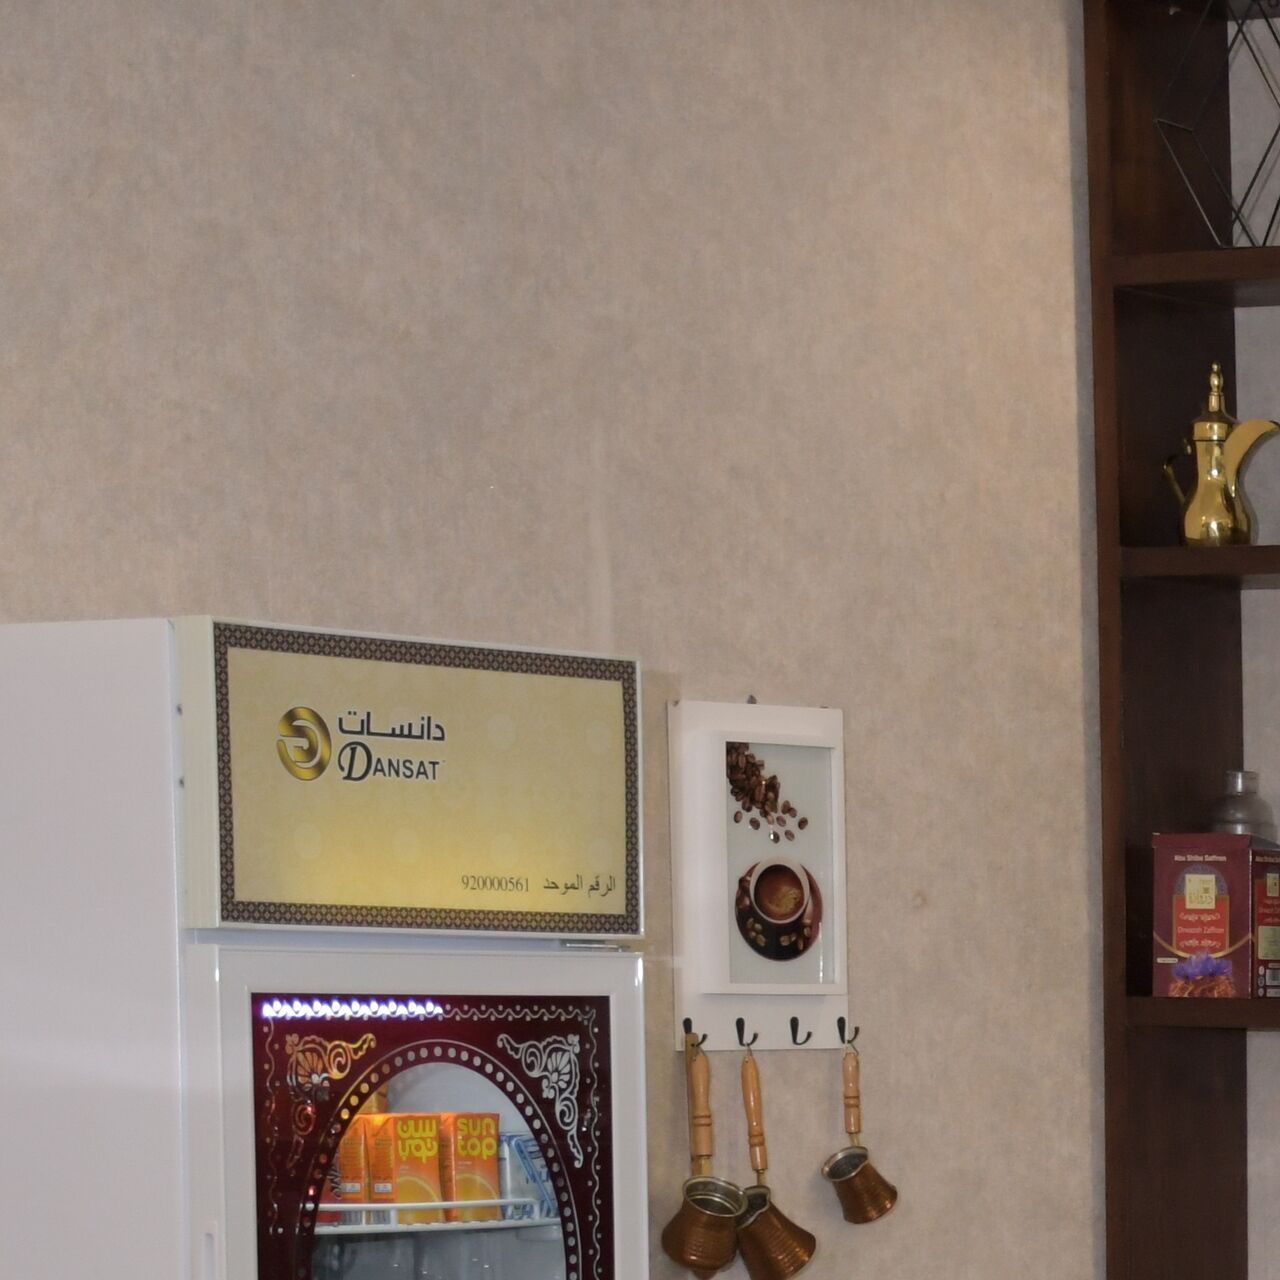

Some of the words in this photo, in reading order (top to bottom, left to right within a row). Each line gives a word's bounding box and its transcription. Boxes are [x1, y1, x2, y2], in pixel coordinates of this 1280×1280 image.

[338, 710, 446, 742] دانسات
[460, 874, 530, 893] 920000561
[543, 873, 584, 896] الموحد
[587, 873, 617, 898] الرقم
[456, 1117, 496, 1136] sun
[456, 1137, 497, 1161] top
